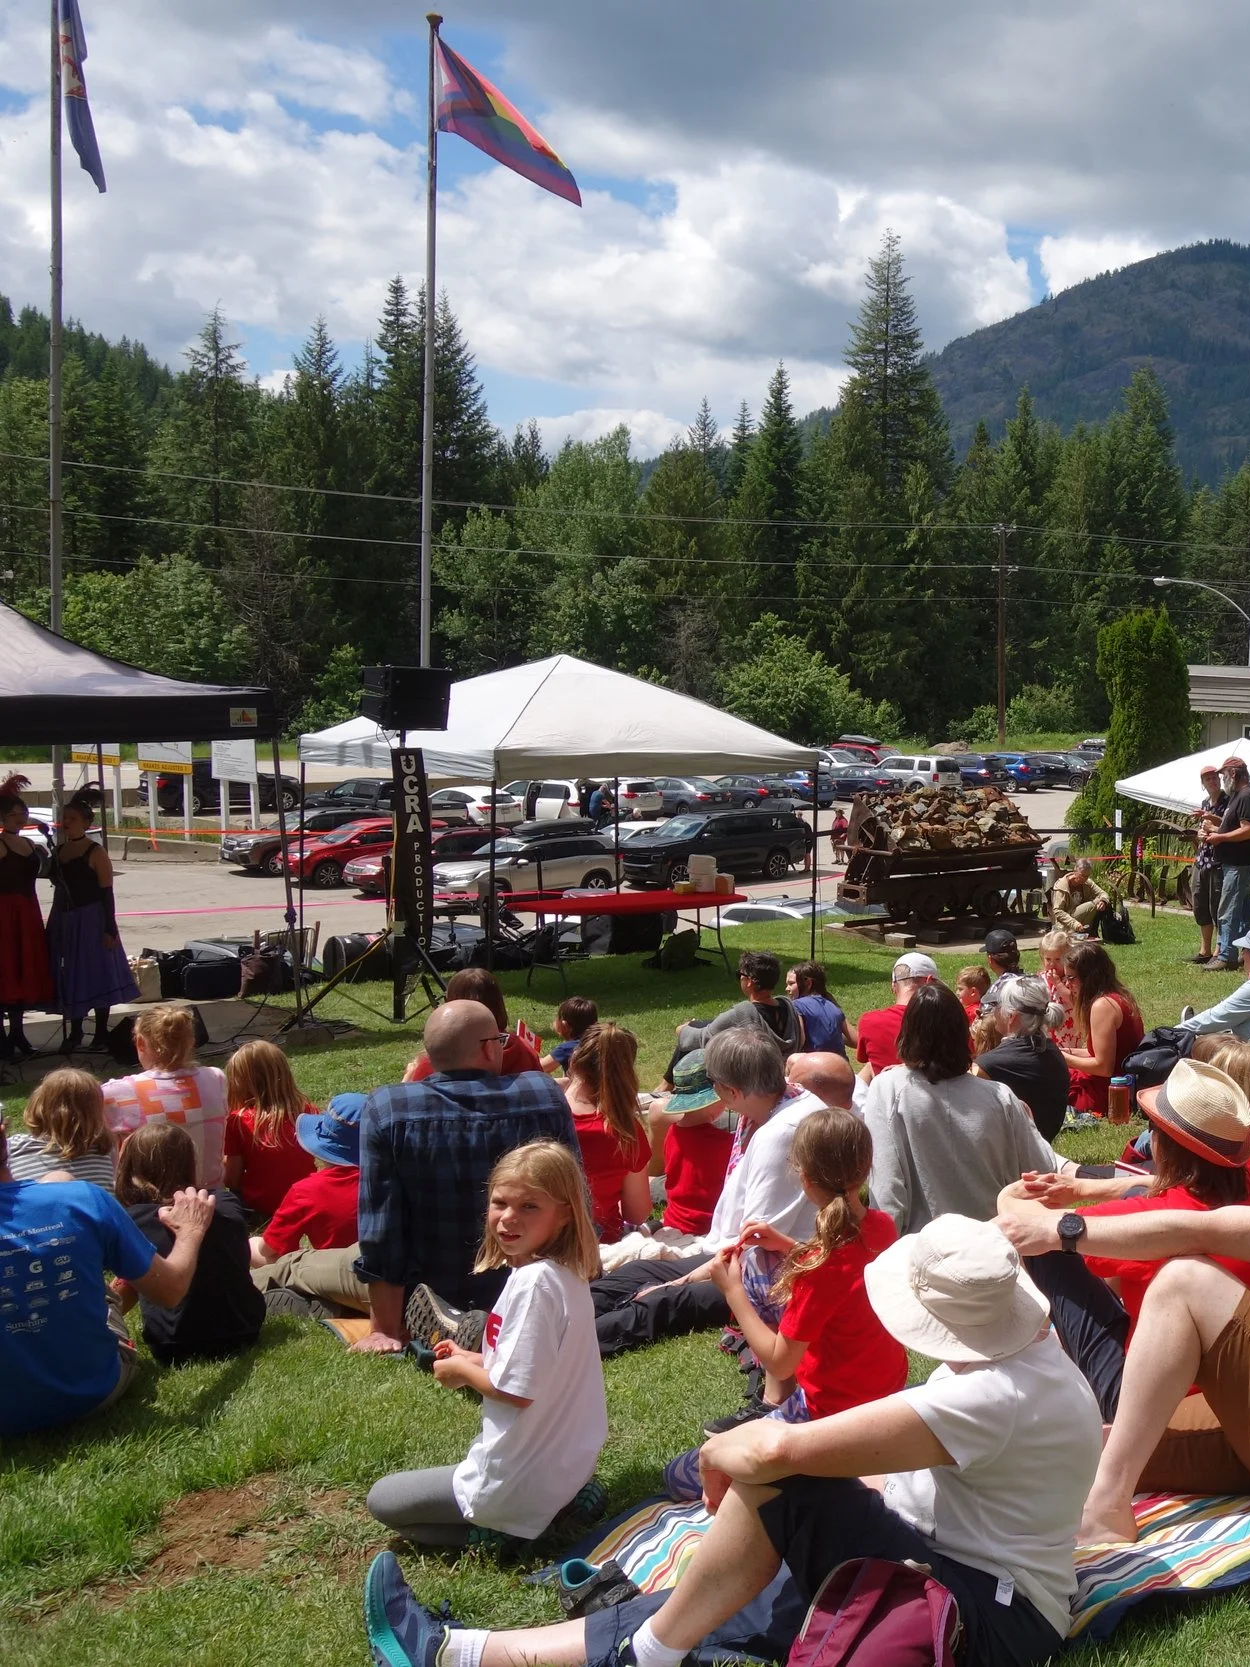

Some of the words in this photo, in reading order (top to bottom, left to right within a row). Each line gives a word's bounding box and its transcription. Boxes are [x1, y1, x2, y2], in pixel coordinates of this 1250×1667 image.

[400, 755, 424, 834] UCRA
[413, 842, 427, 968] PRODUCTIOS
[27, 1221, 64, 1235] Montreal
[29, 1261, 43, 1274] G
